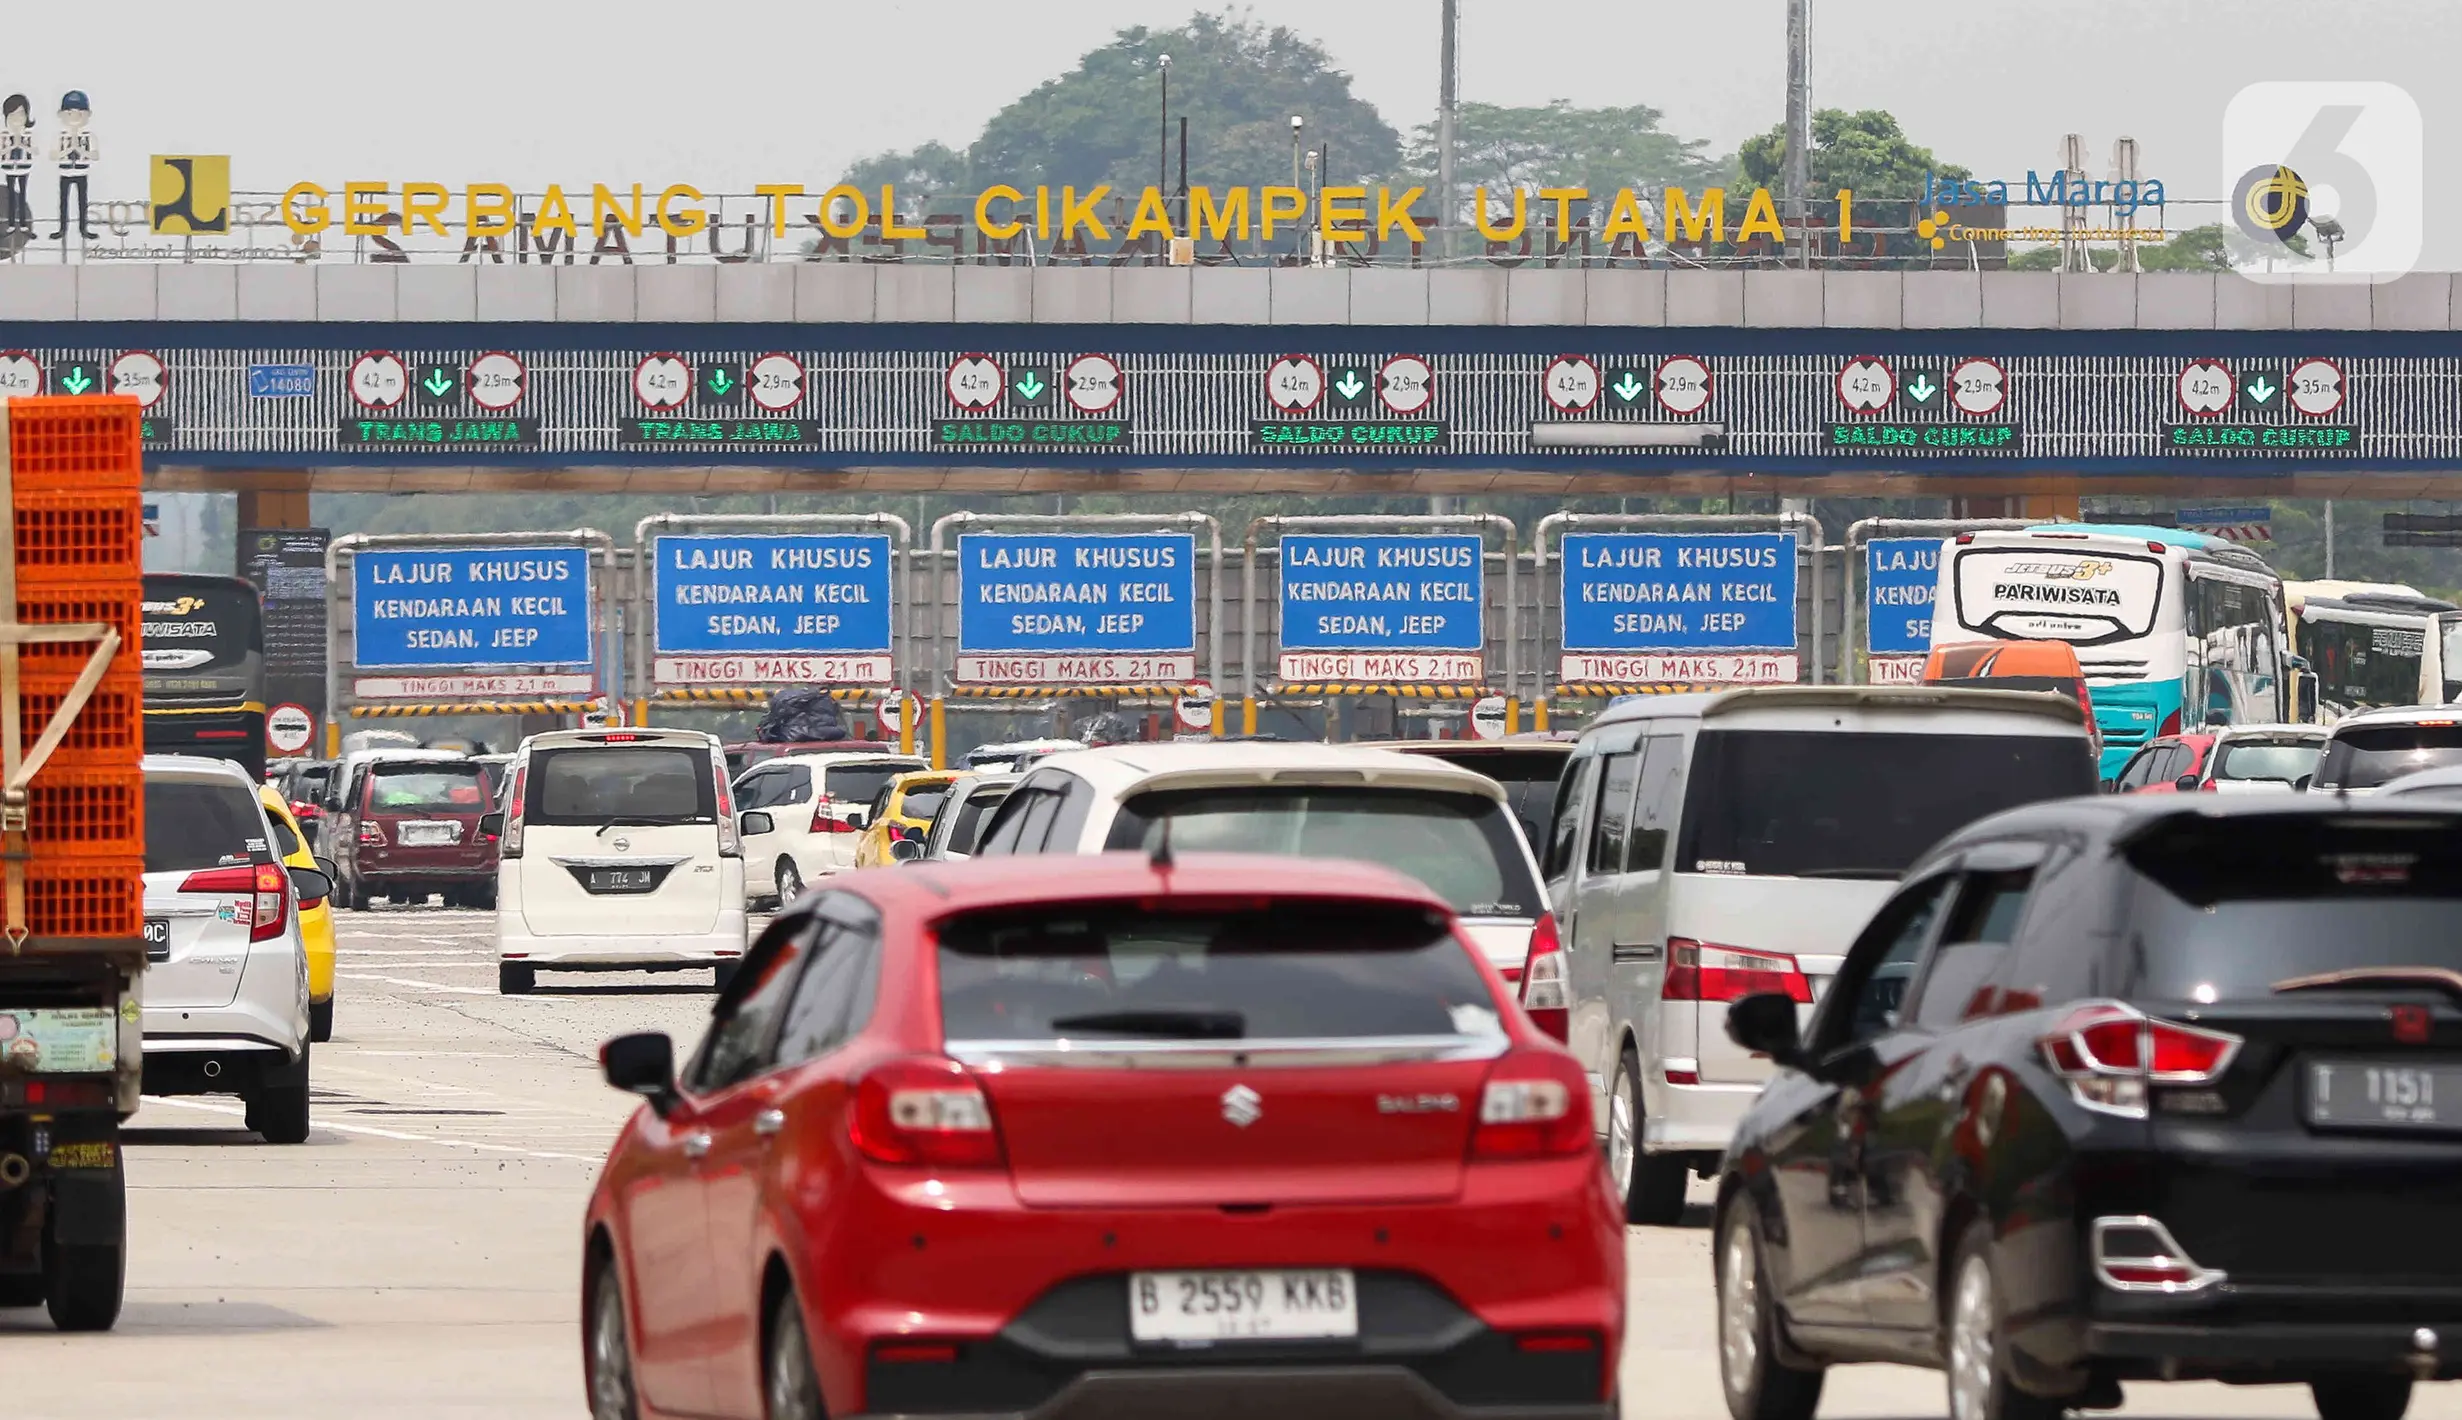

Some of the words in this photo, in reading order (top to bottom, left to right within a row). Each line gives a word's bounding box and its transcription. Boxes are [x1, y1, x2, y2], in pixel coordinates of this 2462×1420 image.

[1919, 170, 2008, 207] Jasa
[2026, 170, 2166, 217] Marga
[281, 182, 706, 238] GERBANG
[755, 184, 926, 239] TOL
[974, 184, 1426, 242] CIKAMPEK
[1475, 186, 1785, 243] UTAMA
[1835, 188, 1852, 243] 1
[1949, 223, 2060, 246] Connecting
[2071, 225, 2166, 242] Indonesia
[270, 377, 312, 393] 14080
[357, 422, 443, 442] TRANS
[448, 422, 521, 442] JAWA
[940, 424, 1025, 444] SALDO
[1032, 423, 1121, 444] CUKUP
[1260, 424, 1344, 444] SALDO
[1350, 424, 1439, 444] CUKUP
[1833, 426, 1918, 446] SALDO
[1923, 426, 2013, 446] CUKUP
[2172, 427, 2256, 447] SALDO
[2261, 427, 2351, 447] CUKUP
[674, 549, 753, 570] LAJUR
[771, 547, 872, 570] KHUSUS
[980, 548, 1057, 569] LAJUR
[1075, 547, 1176, 568] KHUSUS
[1289, 545, 1366, 569] LAJUR
[1377, 546, 1473, 568] KHUSUS
[1581, 547, 1662, 568] LAJUR
[1677, 547, 1777, 568] KHUSUS
[373, 563, 452, 584] LAJUR
[469, 559, 569, 582] KHUSUS
[675, 584, 804, 605] KENDARAAN
[814, 583, 870, 603] KECIL
[980, 583, 1108, 604] KENDARAAN
[1119, 582, 1175, 603] KECIL
[1288, 582, 1411, 602] KENDARAAN
[1420, 582, 1474, 602] KECIL
[1582, 582, 1712, 602] KENDARAAN
[1722, 582, 1777, 602] KECIL
[1994, 583, 2121, 606] PARIWISATA
[374, 600, 501, 619] KENDARAAN
[511, 597, 567, 616] KECIL
[793, 614, 841, 635] JEEP
[1096, 613, 1144, 635] JEEP
[1399, 615, 1447, 635] JEEP
[1700, 612, 1746, 633] JEEP
[491, 628, 539, 648] JEEP
[673, 662, 743, 679] TINGGI
[976, 661, 1046, 679] TINGGI
[1288, 658, 1354, 677] TINGGI
[1581, 658, 1649, 678] TINGGI
[401, 681, 454, 694] TINGGI
[2313, 1065, 2335, 1102] T
[2366, 1068, 2434, 1105] 1151
[1140, 1277, 1159, 1315] B
[1178, 1276, 1263, 1316] 2559
[1282, 1275, 1347, 1312] KKB
